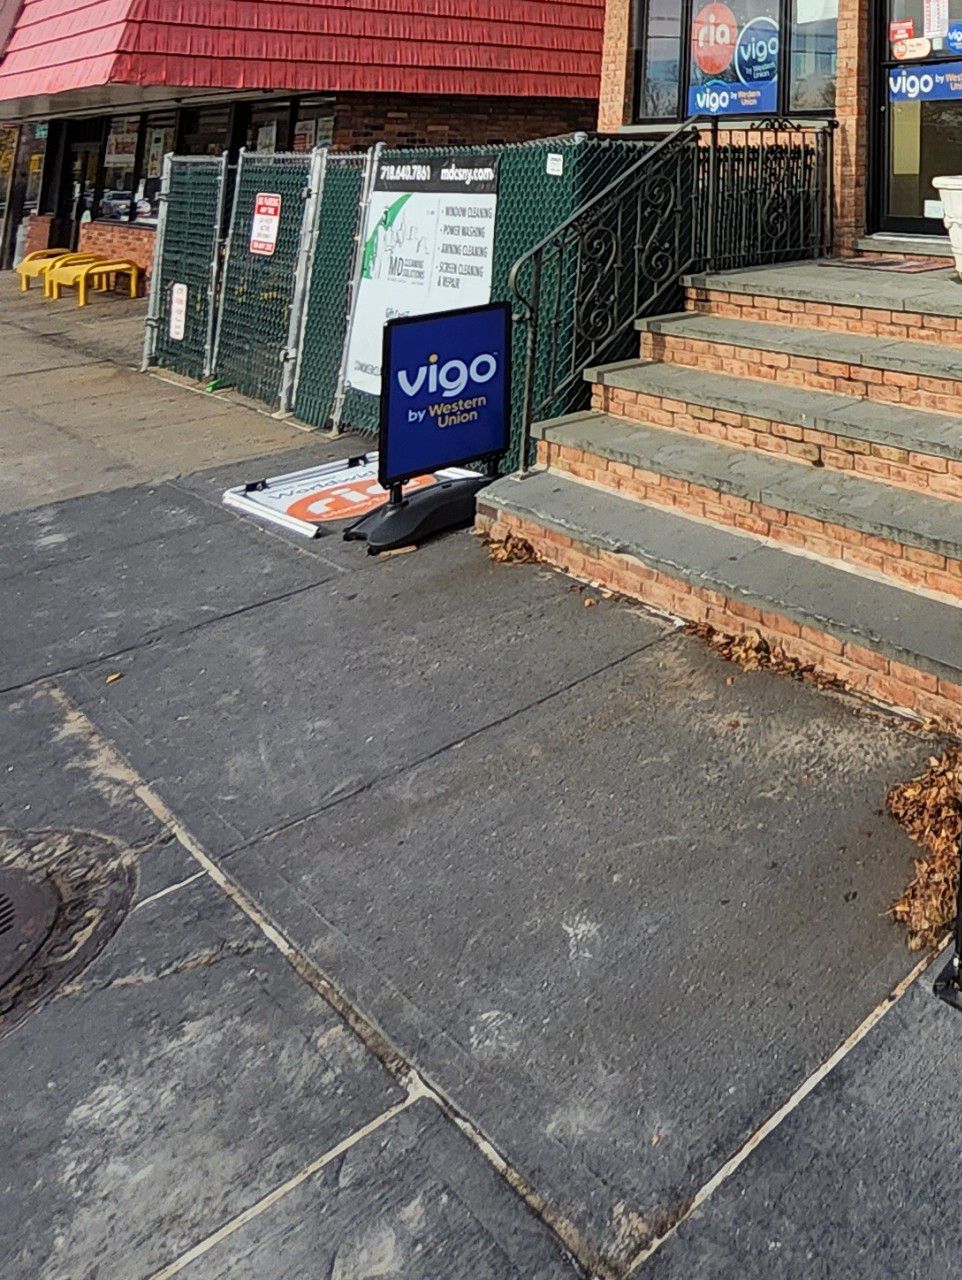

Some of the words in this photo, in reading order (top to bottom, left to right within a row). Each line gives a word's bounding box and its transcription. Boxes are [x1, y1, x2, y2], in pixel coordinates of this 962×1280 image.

[699, 14, 730, 48] ria
[740, 36, 779, 63] vigo
[888, 70, 934, 98] vigo
[935, 74, 945, 85] by
[696, 87, 730, 112] vigo
[445, 206, 467, 218] WINDOW
[467, 207, 493, 219] CLEANING
[388, 256, 404, 278] MD
[397, 353, 498, 397] vigo
[408, 409, 427, 423] by
[428, 396, 487, 418] Western
[437, 411, 478, 429] Union
